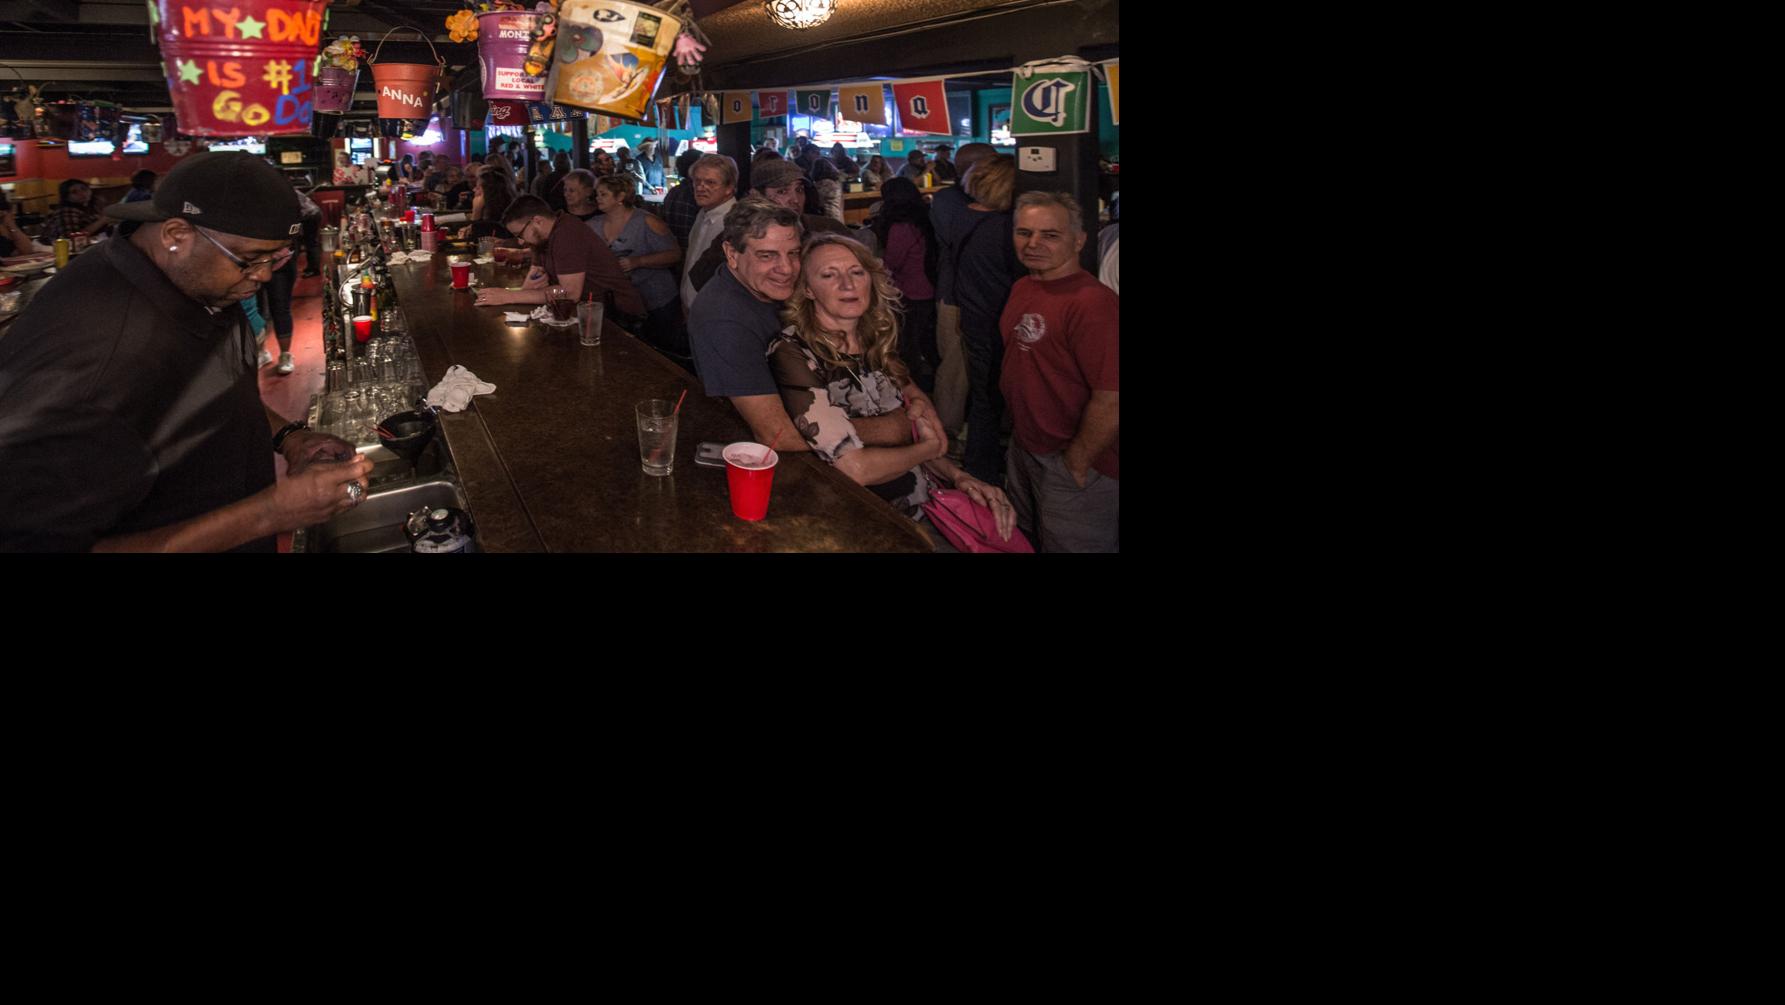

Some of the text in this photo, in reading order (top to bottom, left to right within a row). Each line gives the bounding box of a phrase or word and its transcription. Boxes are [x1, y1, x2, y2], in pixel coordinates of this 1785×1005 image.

[182, 6, 241, 39] MY
[206, 60, 247, 89] IS
[382, 86, 423, 108] ANNA
